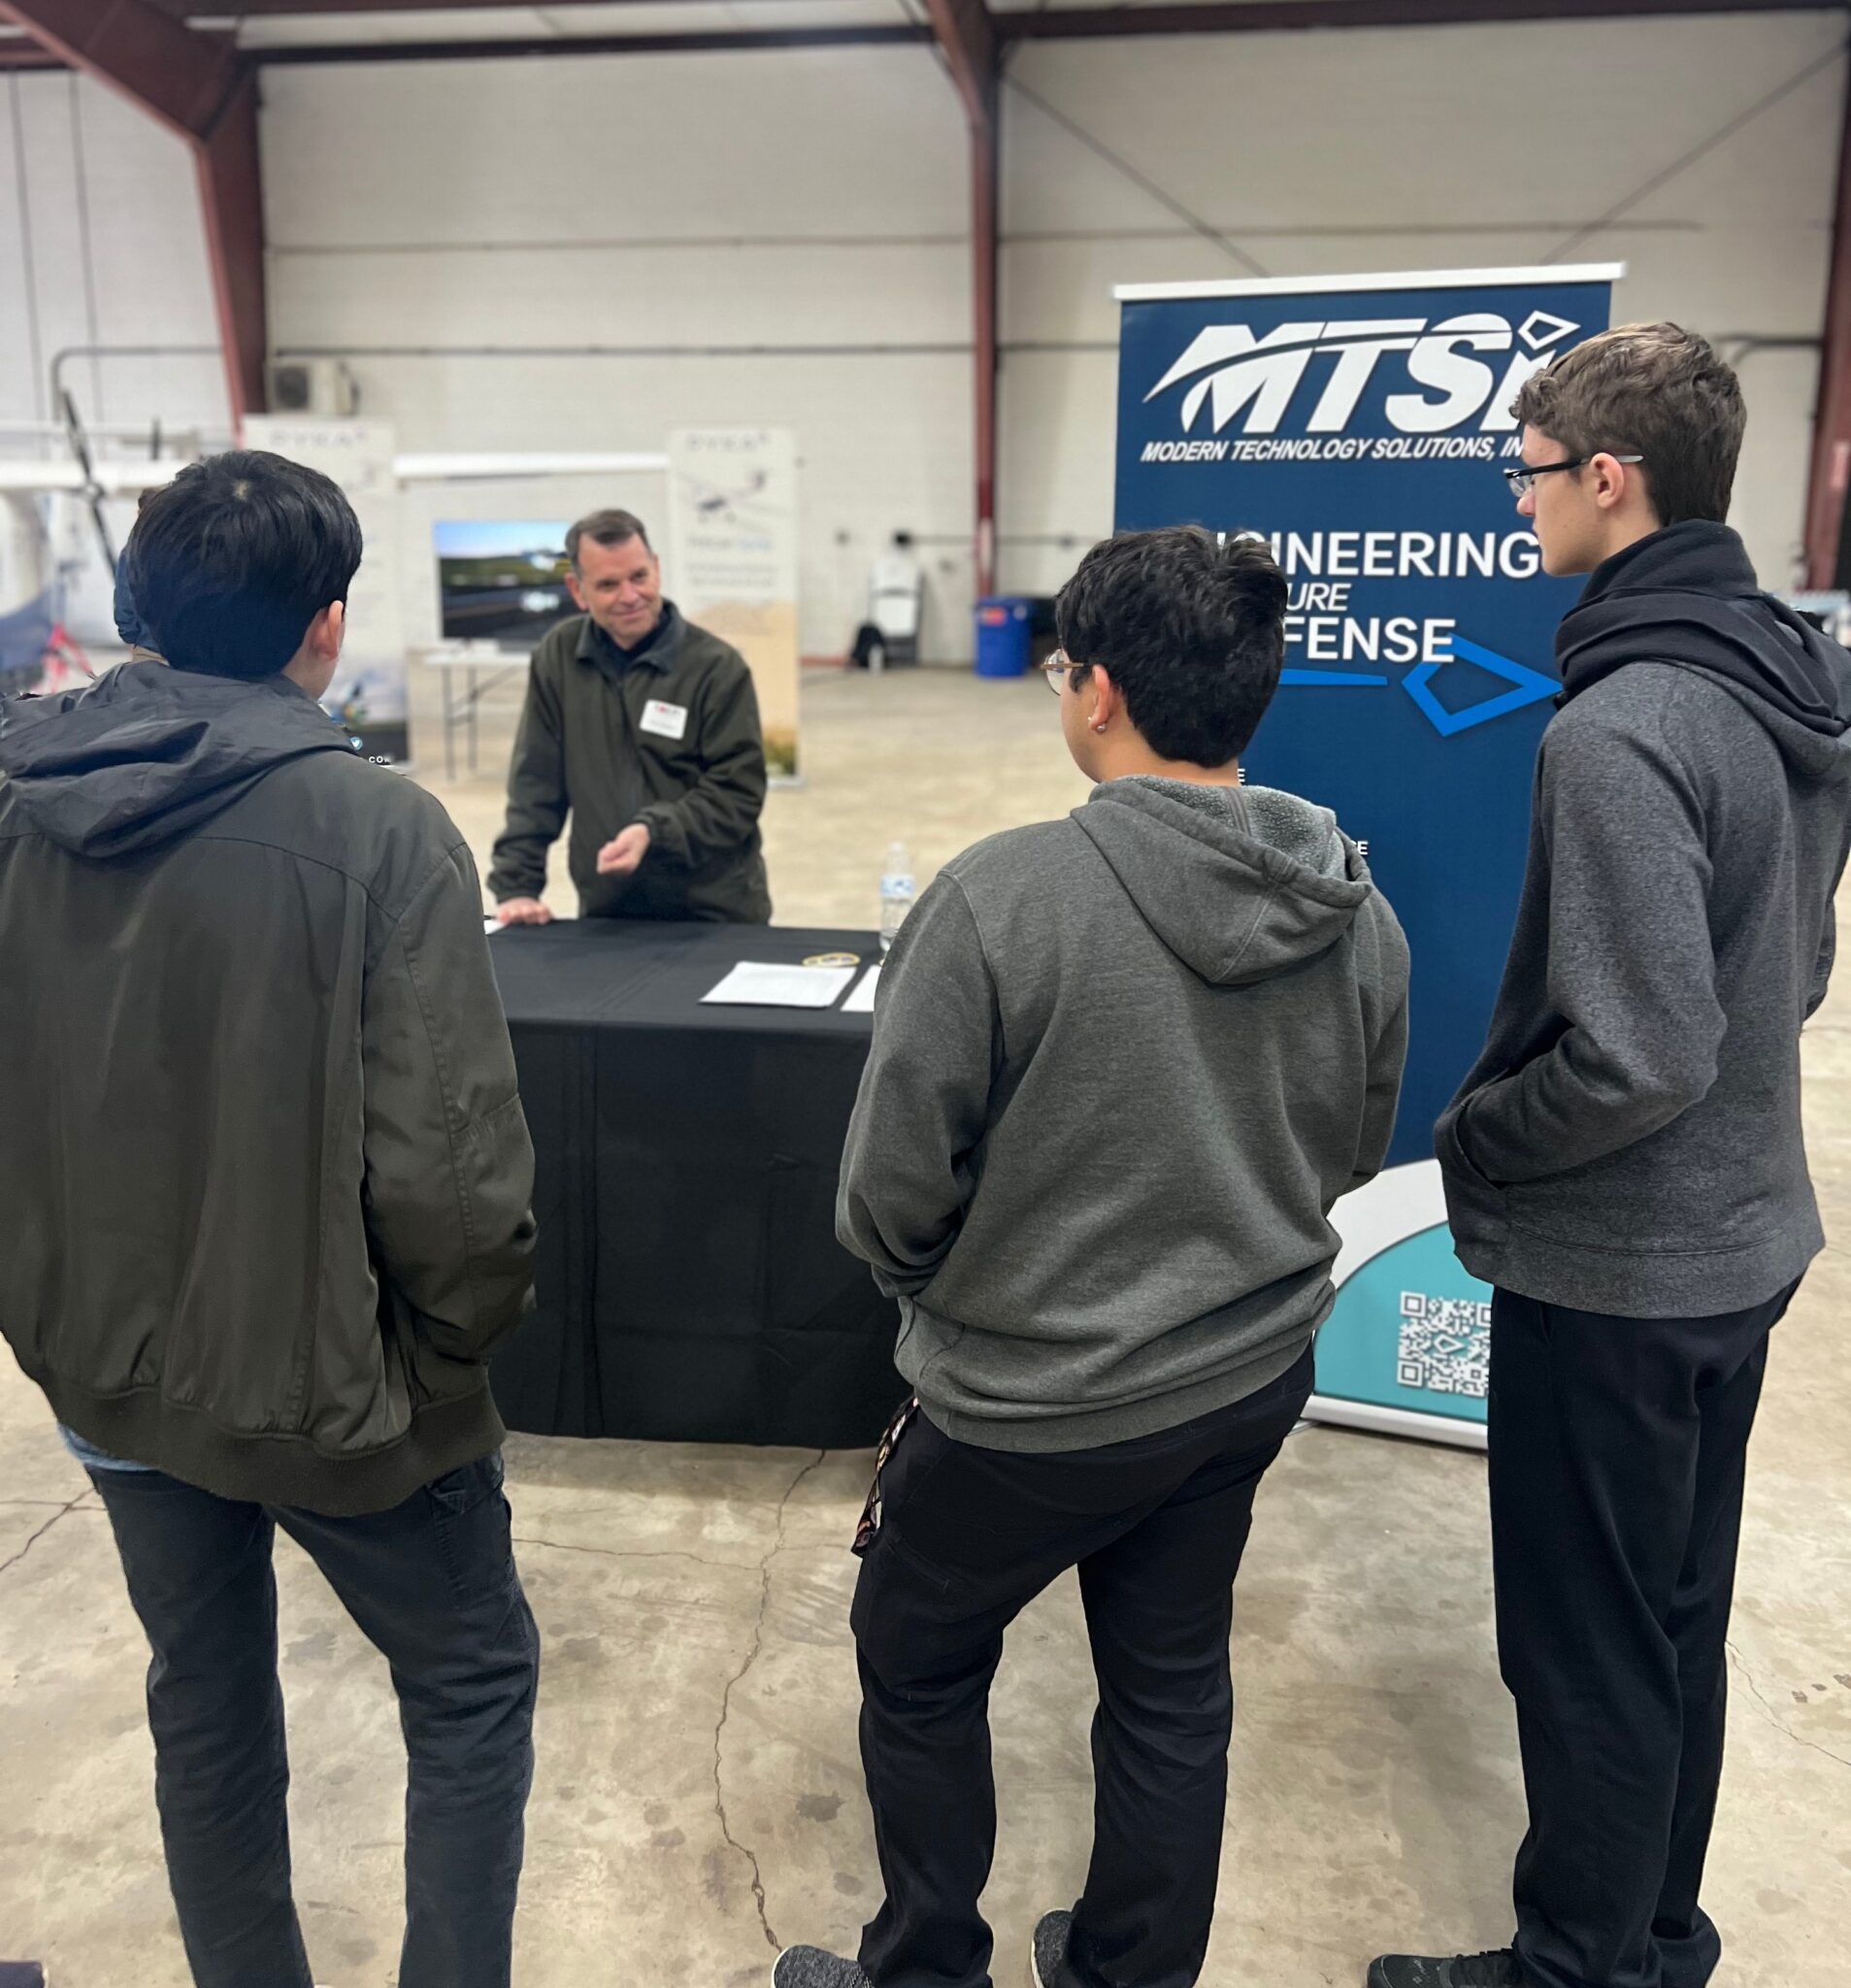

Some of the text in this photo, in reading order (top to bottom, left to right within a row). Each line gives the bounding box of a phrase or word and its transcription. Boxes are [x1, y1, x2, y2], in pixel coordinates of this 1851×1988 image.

[1140, 436, 1524, 463] MODERN TECHNOLOGY SOLUTIONS, IN
[1216, 531, 1540, 580] INEERING
[1285, 582, 1352, 612] URE
[1280, 616, 1456, 663] FENSE
